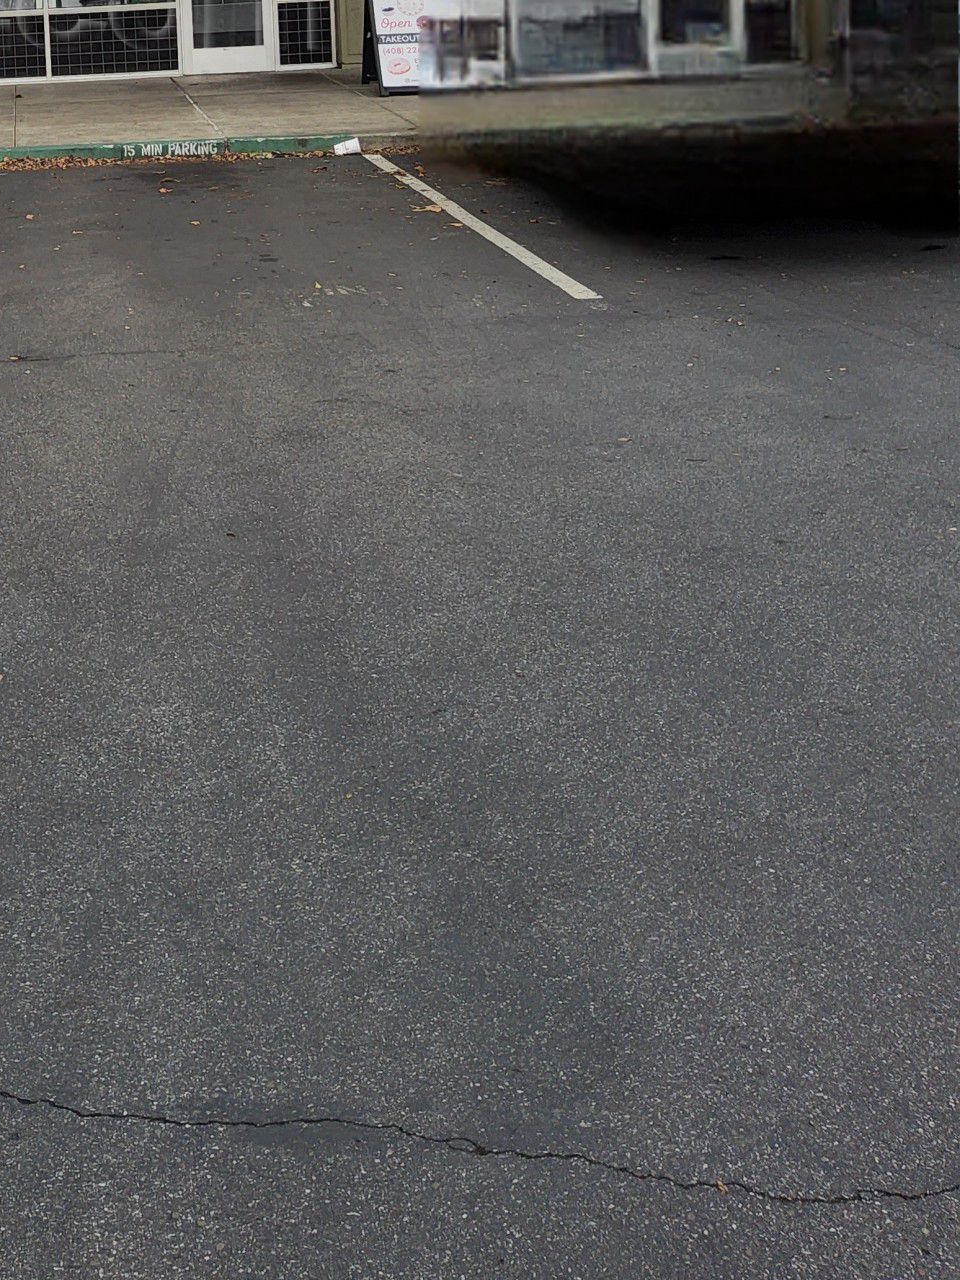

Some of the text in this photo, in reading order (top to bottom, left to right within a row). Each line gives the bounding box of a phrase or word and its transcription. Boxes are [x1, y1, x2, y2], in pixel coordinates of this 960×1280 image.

[381, 18, 412, 31] Open
[123, 141, 218, 157] 15 MIN PARKING
